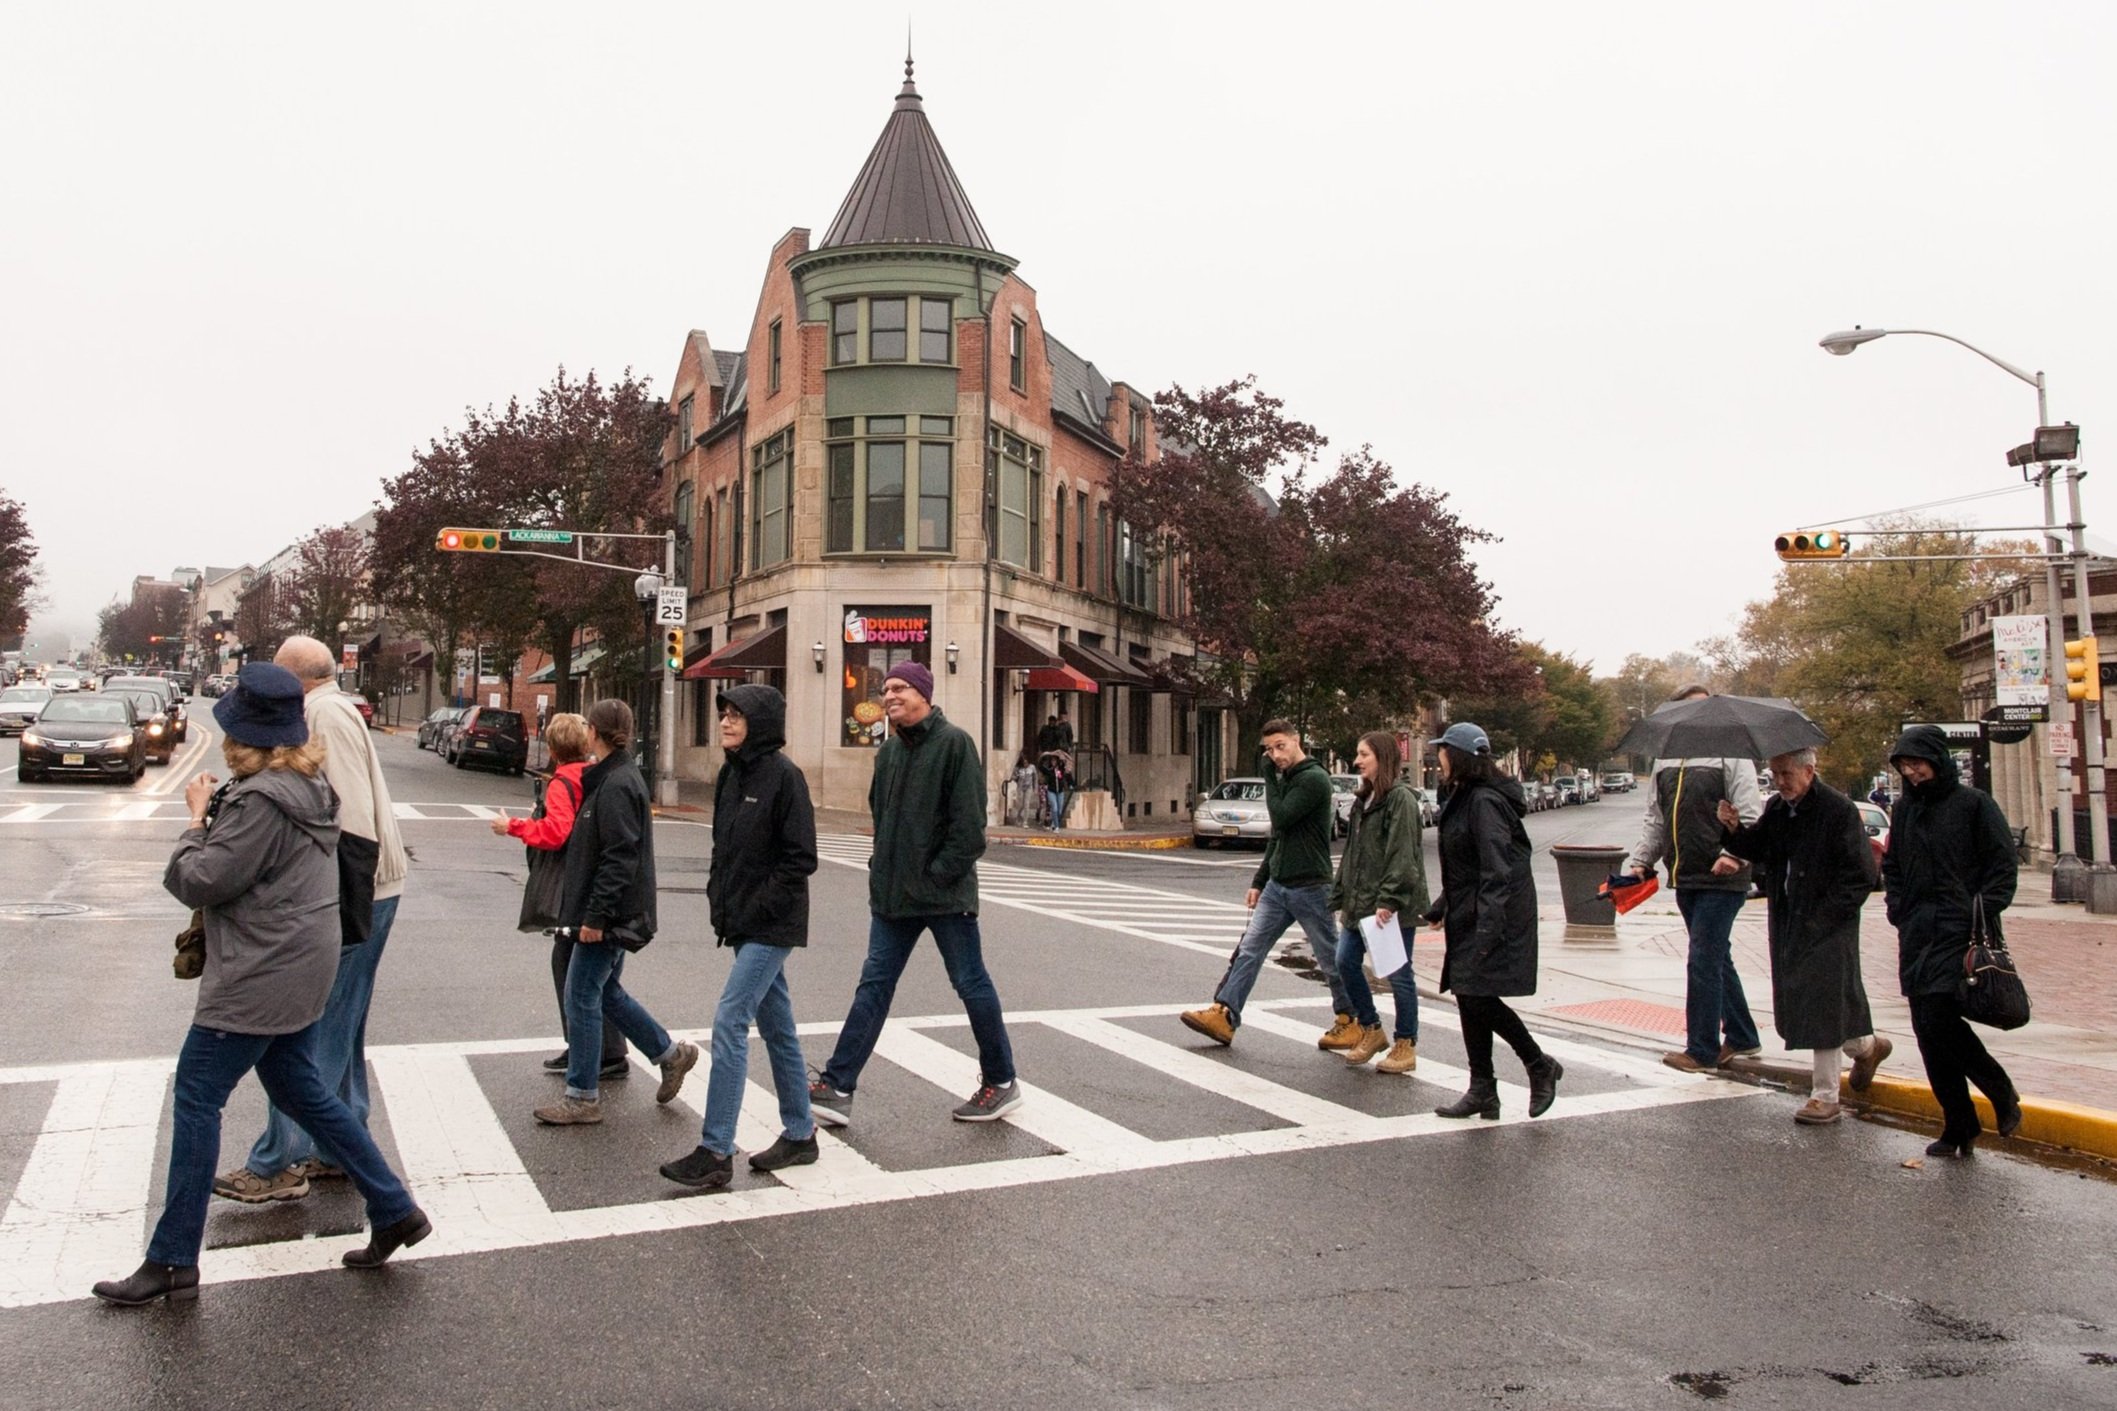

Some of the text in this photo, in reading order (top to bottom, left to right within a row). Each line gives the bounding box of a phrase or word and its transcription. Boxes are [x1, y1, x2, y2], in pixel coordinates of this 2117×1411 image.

[661, 590, 685, 598] SPEED
[661, 606, 683, 620] 25
[867, 630, 925, 642] DONUTS
